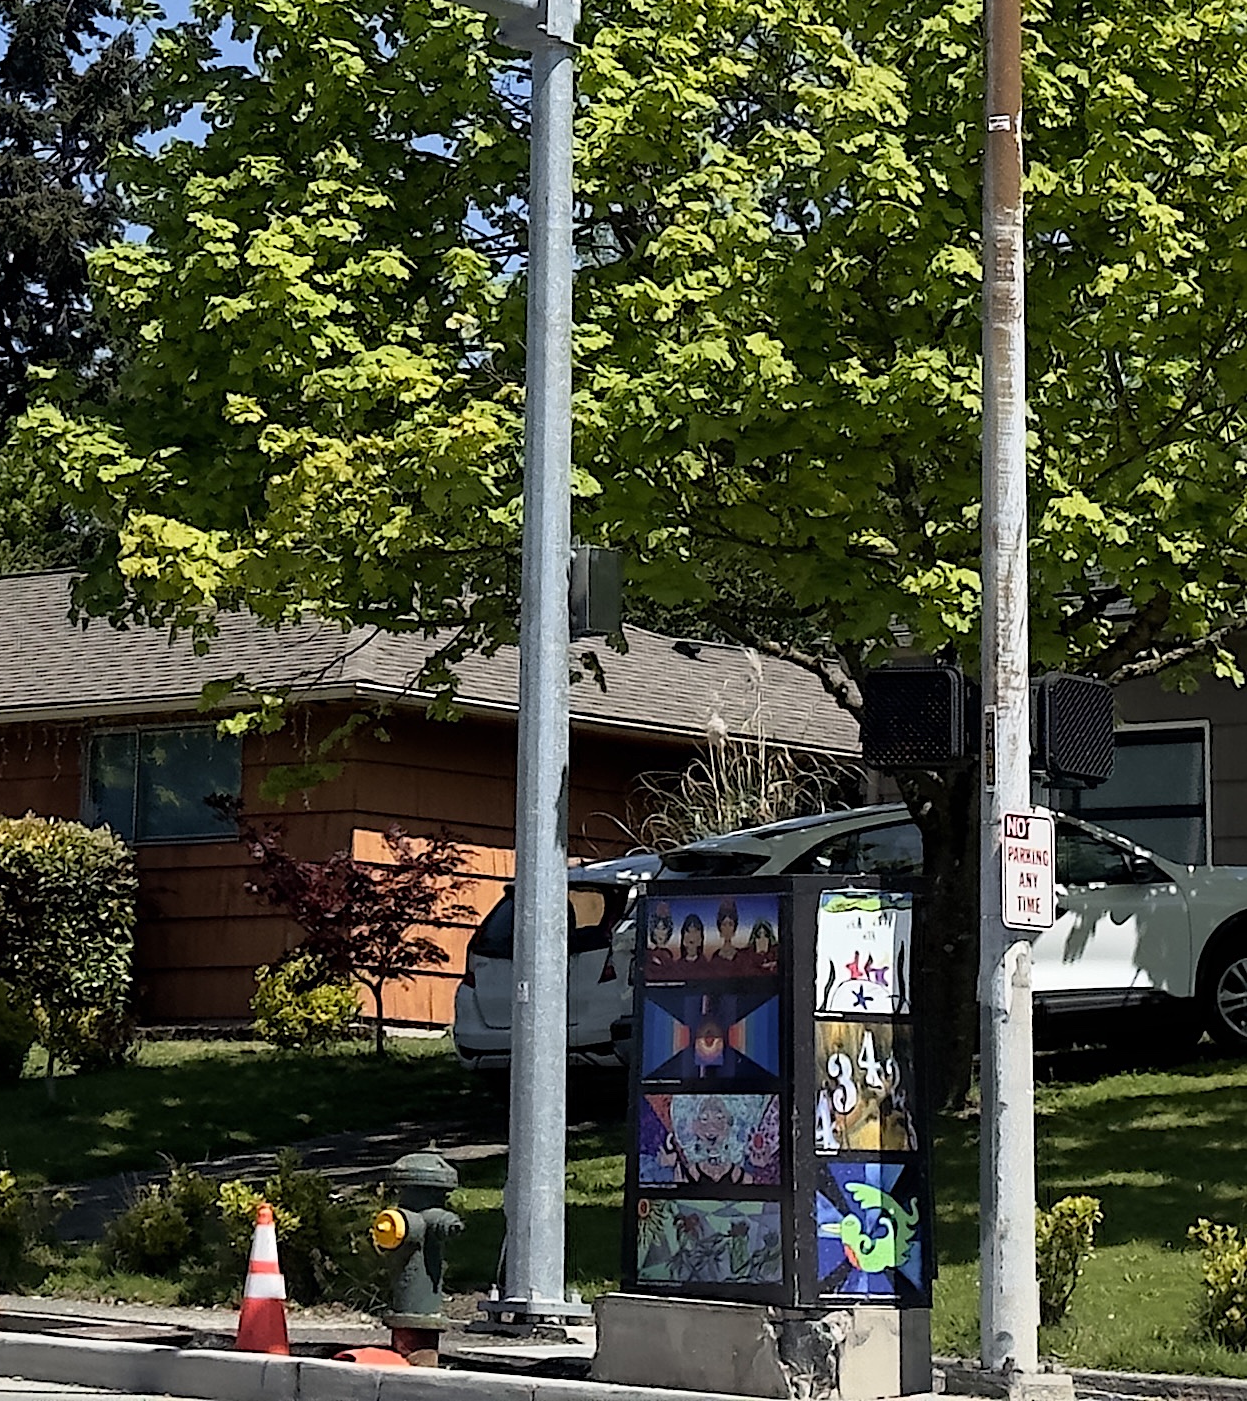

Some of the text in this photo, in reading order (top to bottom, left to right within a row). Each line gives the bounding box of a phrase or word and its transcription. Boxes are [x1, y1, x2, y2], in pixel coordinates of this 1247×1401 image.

[1006, 815, 1028, 838] NO
[1007, 846, 1049, 867] PARKING
[1018, 871, 1039, 888] ANY
[1016, 895, 1042, 914] TIME
[858, 1030, 884, 1089] 4
[827, 1052, 858, 1114] 3
